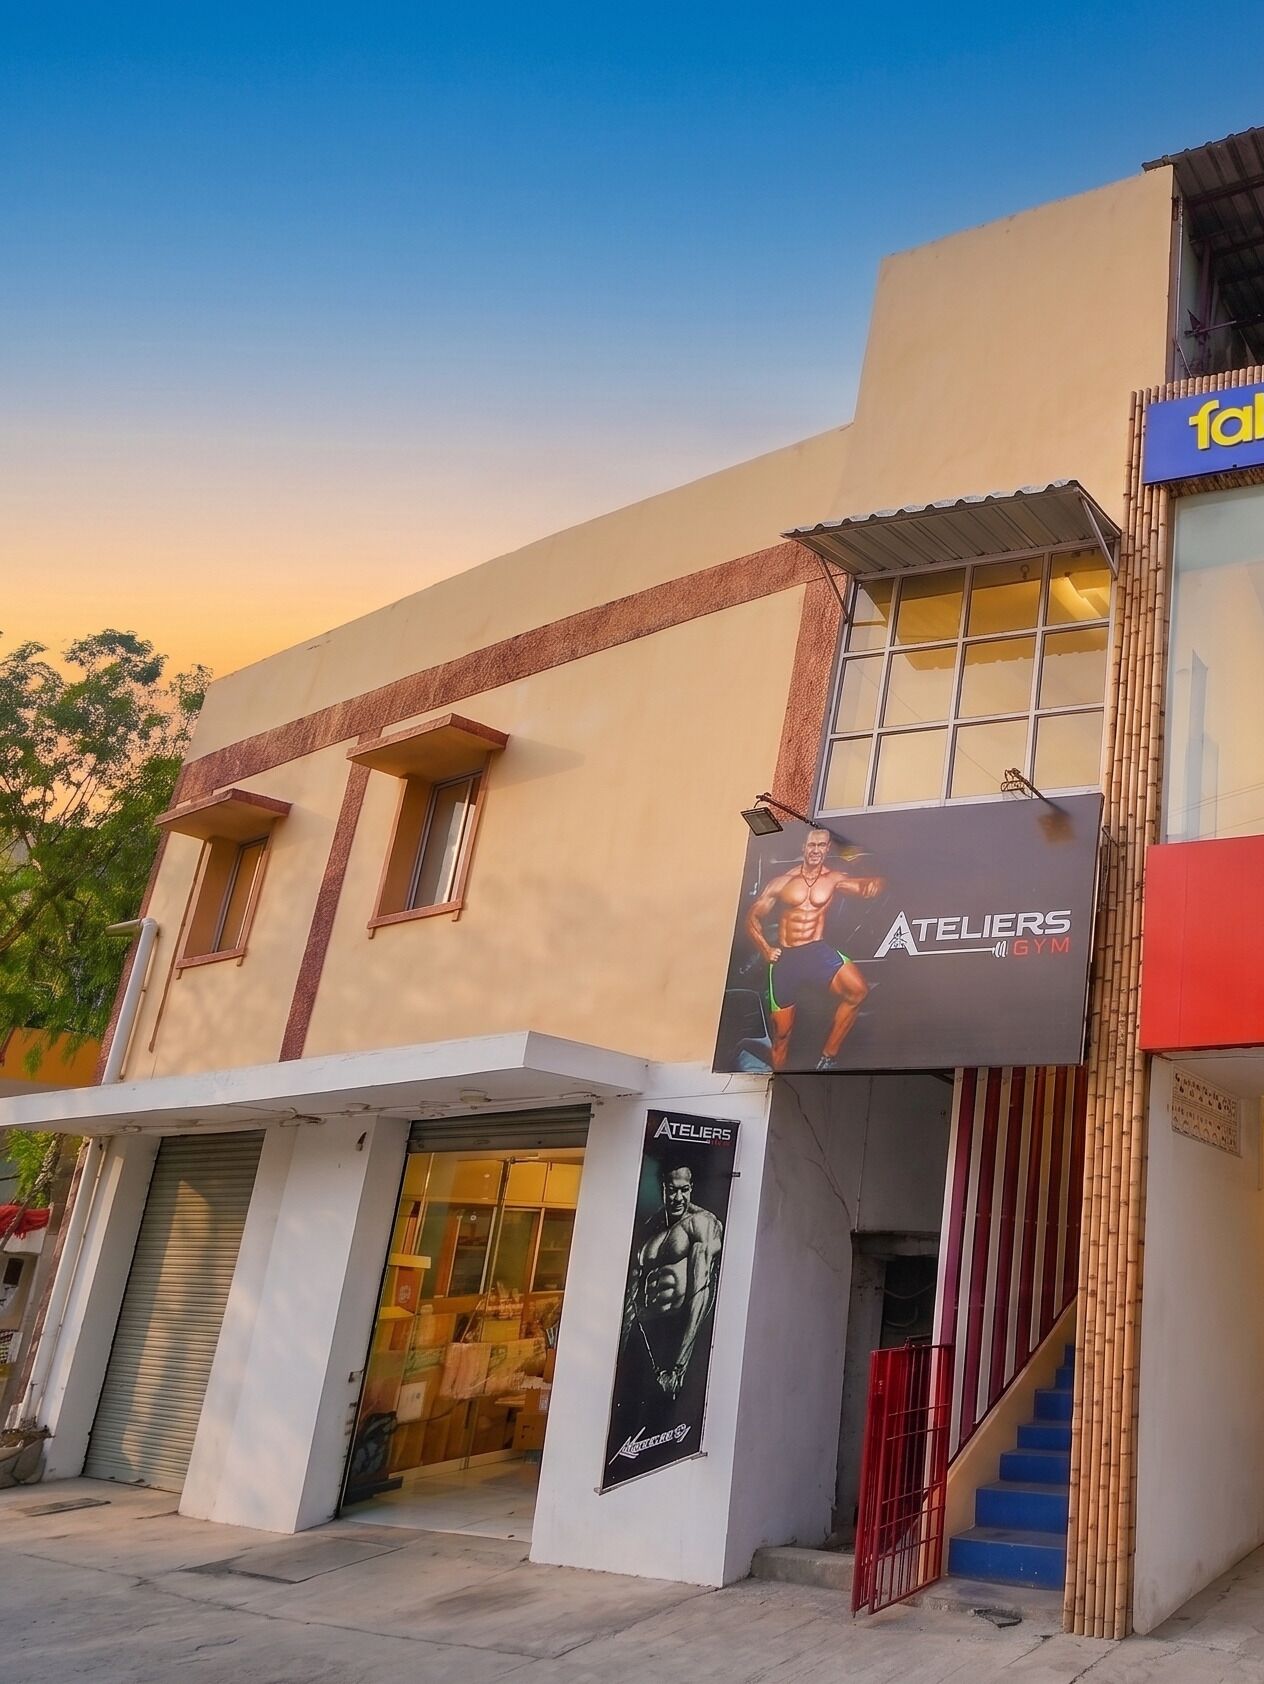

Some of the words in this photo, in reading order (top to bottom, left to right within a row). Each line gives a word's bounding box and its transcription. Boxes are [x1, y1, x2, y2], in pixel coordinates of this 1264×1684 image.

[873, 910, 1072, 958] ATELIERS
[1013, 937, 1071, 957] GYM
[653, 1116, 732, 1141] ATELIERS
